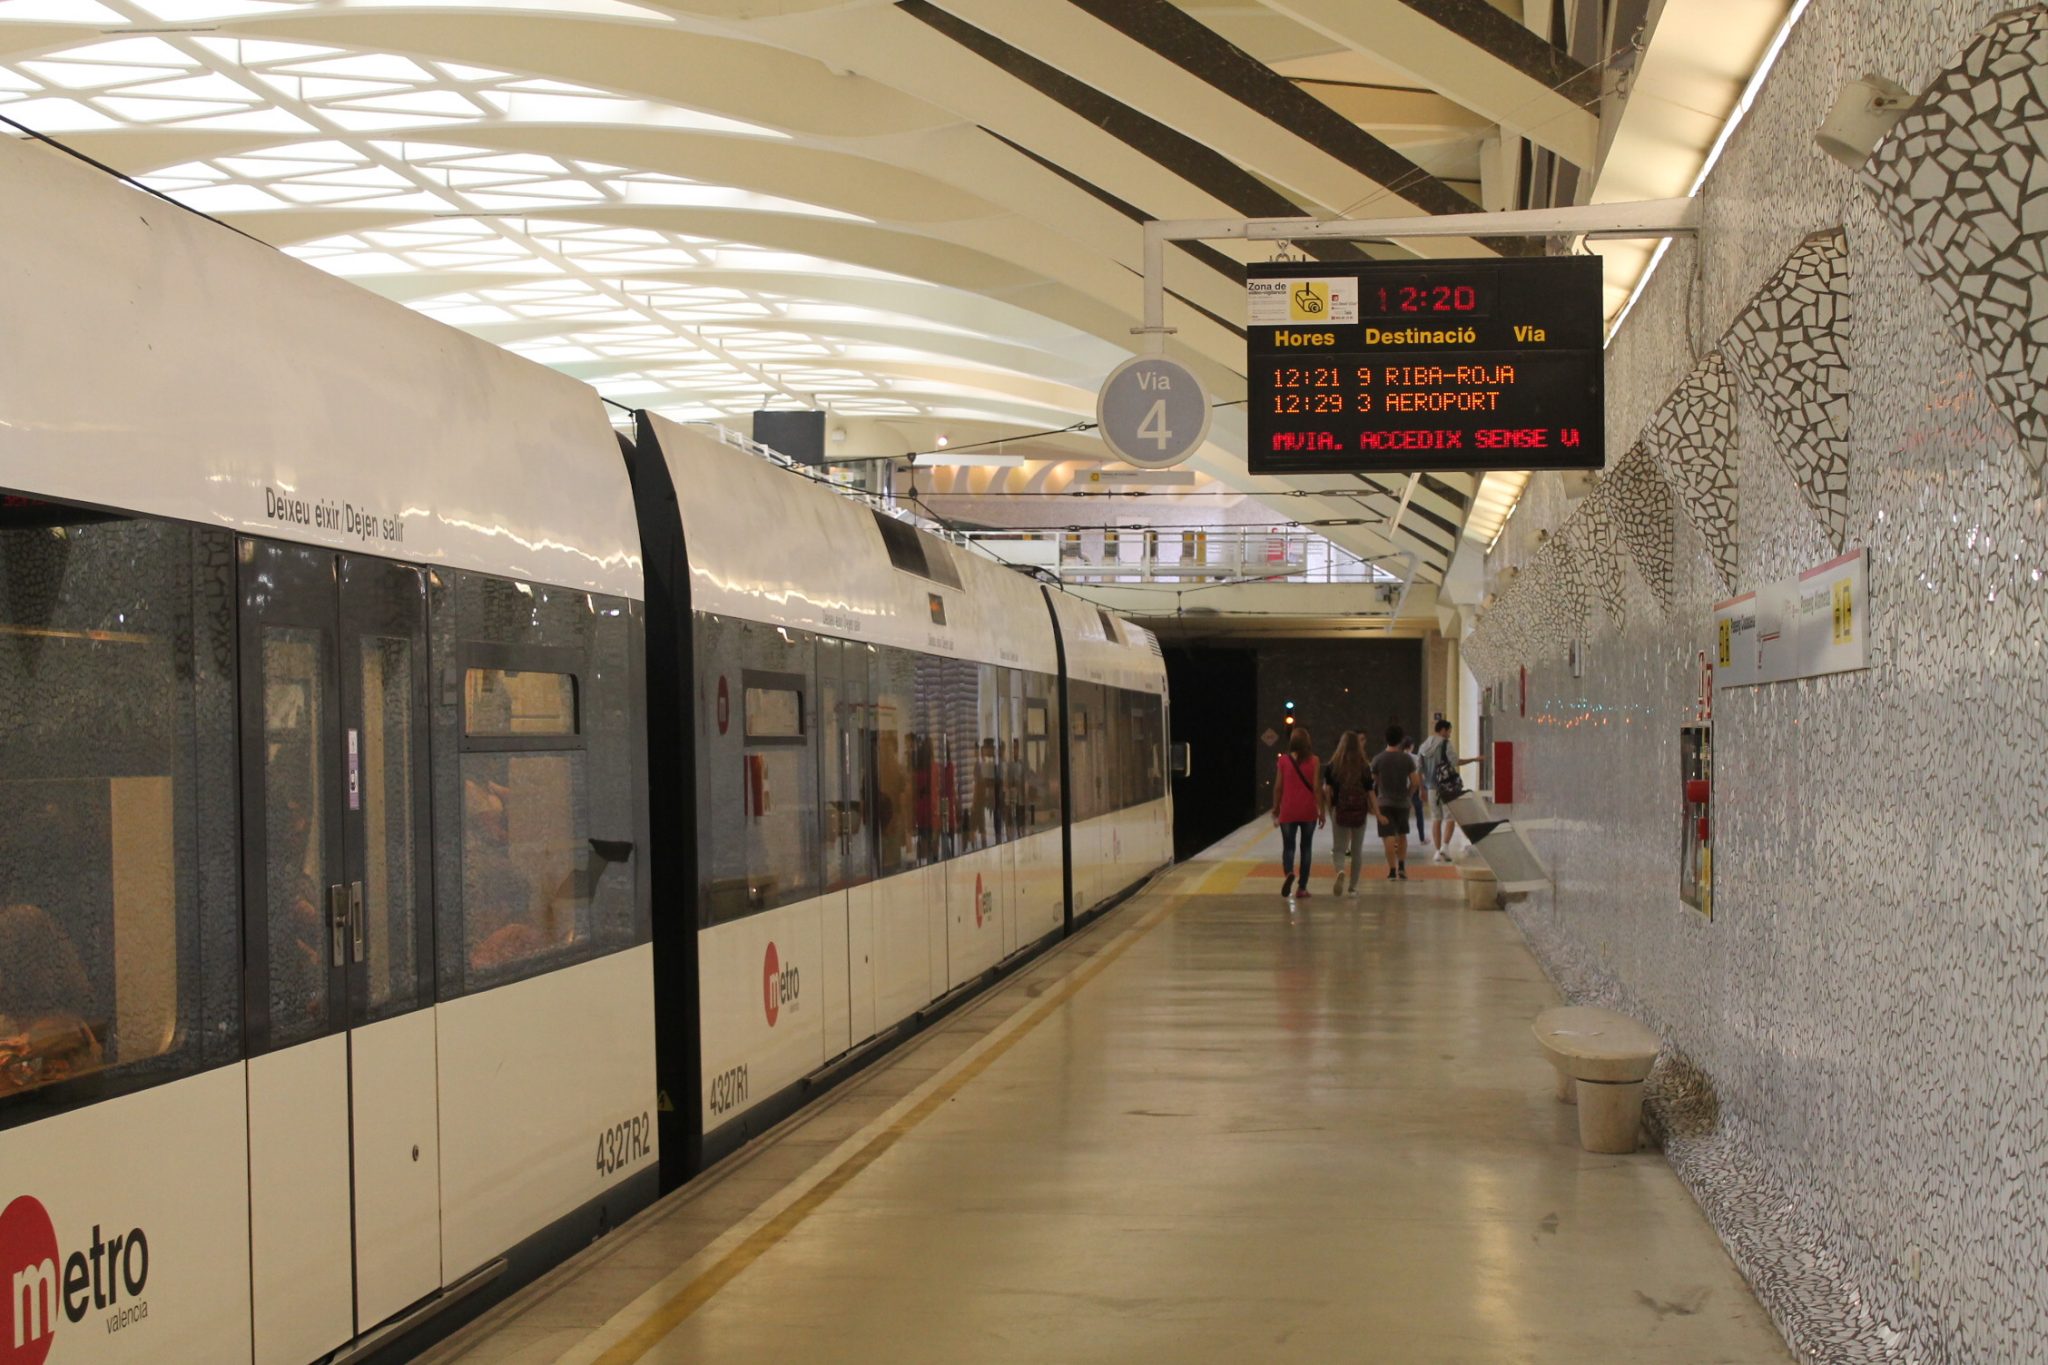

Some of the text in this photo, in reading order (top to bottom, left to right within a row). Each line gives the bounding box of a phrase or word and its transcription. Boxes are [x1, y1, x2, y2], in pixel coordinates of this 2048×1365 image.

[1248, 282, 1287, 291] Zona de
[1274, 325, 1546, 347] Hores Destinació Via
[1136, 371, 1171, 391] Via
[1274, 364, 1515, 388] 12:21 9 RIBA-ROJA
[1274, 390, 1501, 414] 12:29 3 AEROPORT
[1136, 398, 1173, 450] 4
[1359, 429, 1463, 450] ACCEDIX
[265, 486, 310, 525] Deixeu
[382, 514, 405, 543] salir
[769, 960, 800, 1009] metro
[709, 1062, 750, 1117] 4327R1
[596, 1110, 650, 1178] 4327R2
[12, 1223, 149, 1350] metro
[105, 1297, 149, 1335] valencia
